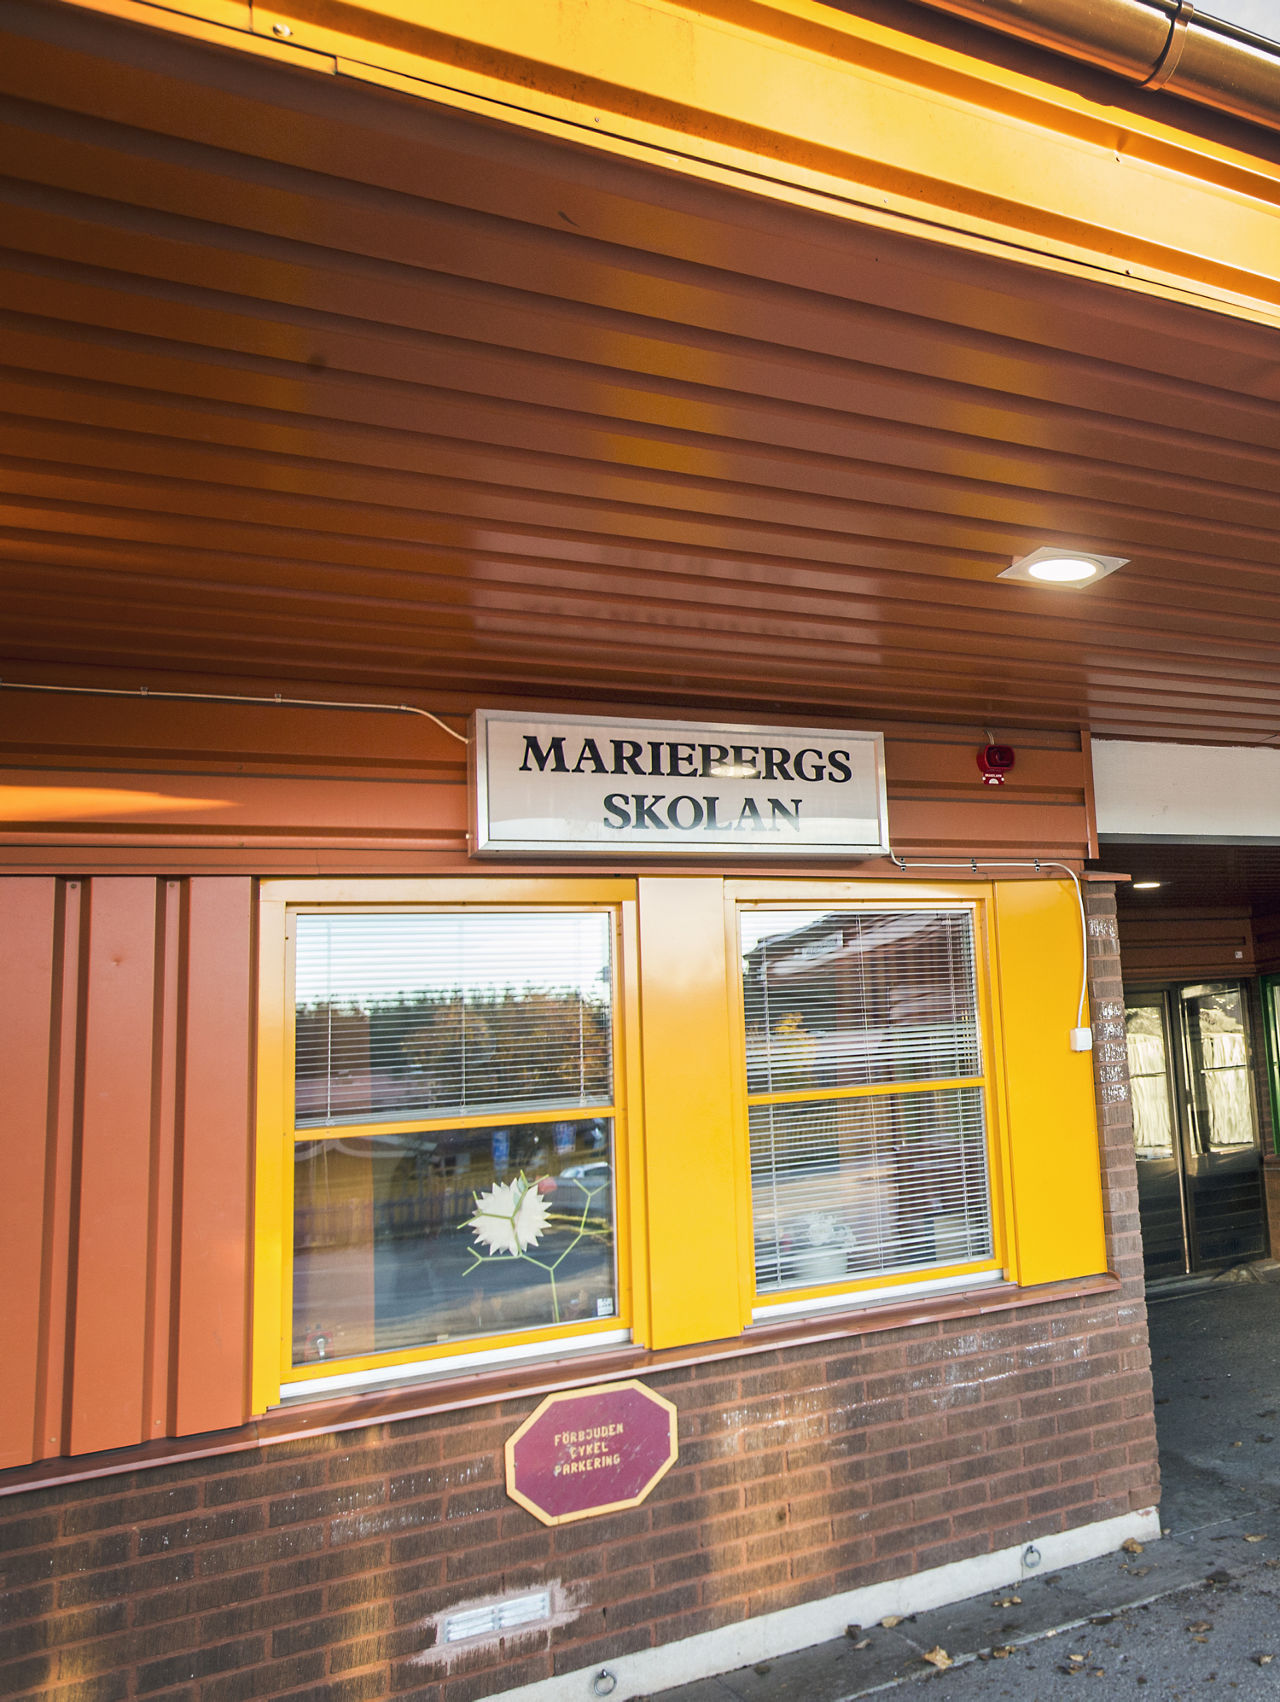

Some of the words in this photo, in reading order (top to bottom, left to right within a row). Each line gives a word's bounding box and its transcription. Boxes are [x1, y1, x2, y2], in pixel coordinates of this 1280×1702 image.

[519, 735, 853, 783] MARIEBERGS
[603, 793, 803, 832] SKOLAN
[554, 1422, 624, 1447] FÖRBJUDEN
[570, 1441, 609, 1460] CYKEL
[554, 1453, 621, 1477] PARKERING
